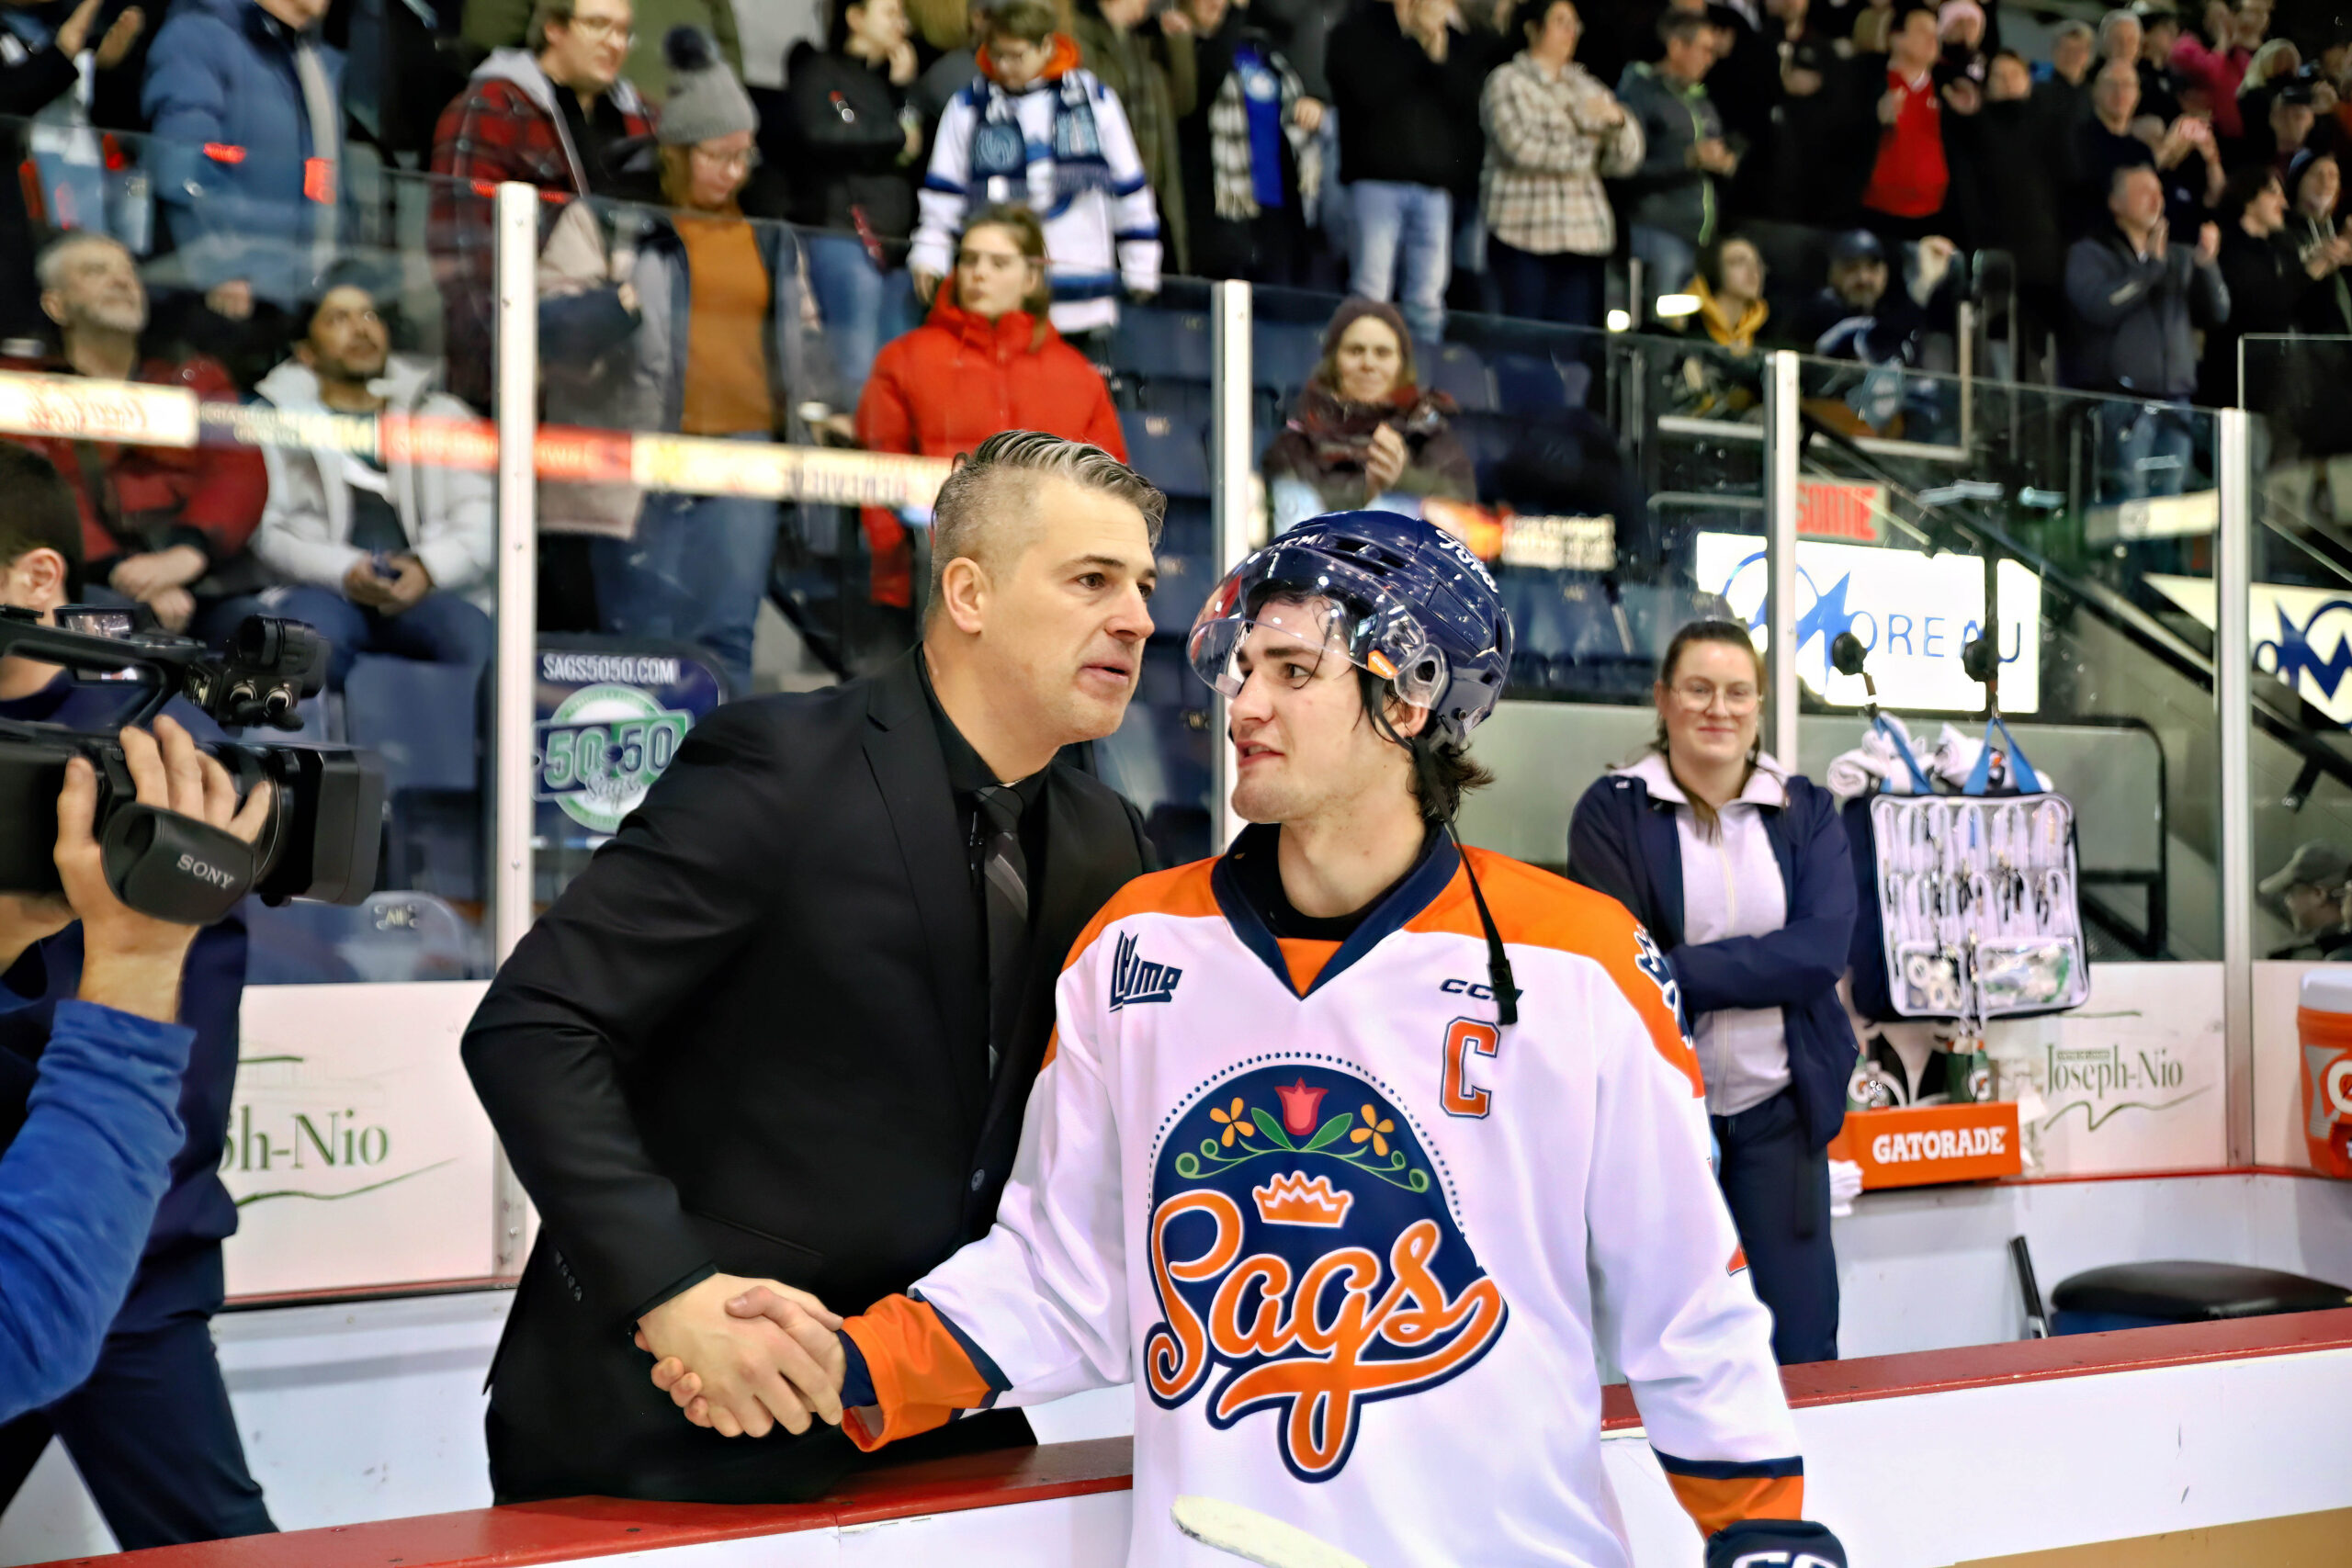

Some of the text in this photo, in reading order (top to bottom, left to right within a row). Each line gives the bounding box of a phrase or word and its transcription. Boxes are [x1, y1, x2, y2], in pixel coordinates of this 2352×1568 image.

[543, 653, 681, 685] SAGS5050.COM
[544, 719, 680, 789] 50 50
[176, 853, 235, 890] SONY
[1440, 978, 1523, 1002] CC
[1440, 1016, 1500, 1120] C
[2045, 1043, 2184, 1100] Joseph-Nio
[1872, 1126, 2007, 1164] GATORADE
[1145, 1188, 1507, 1478] Sags
